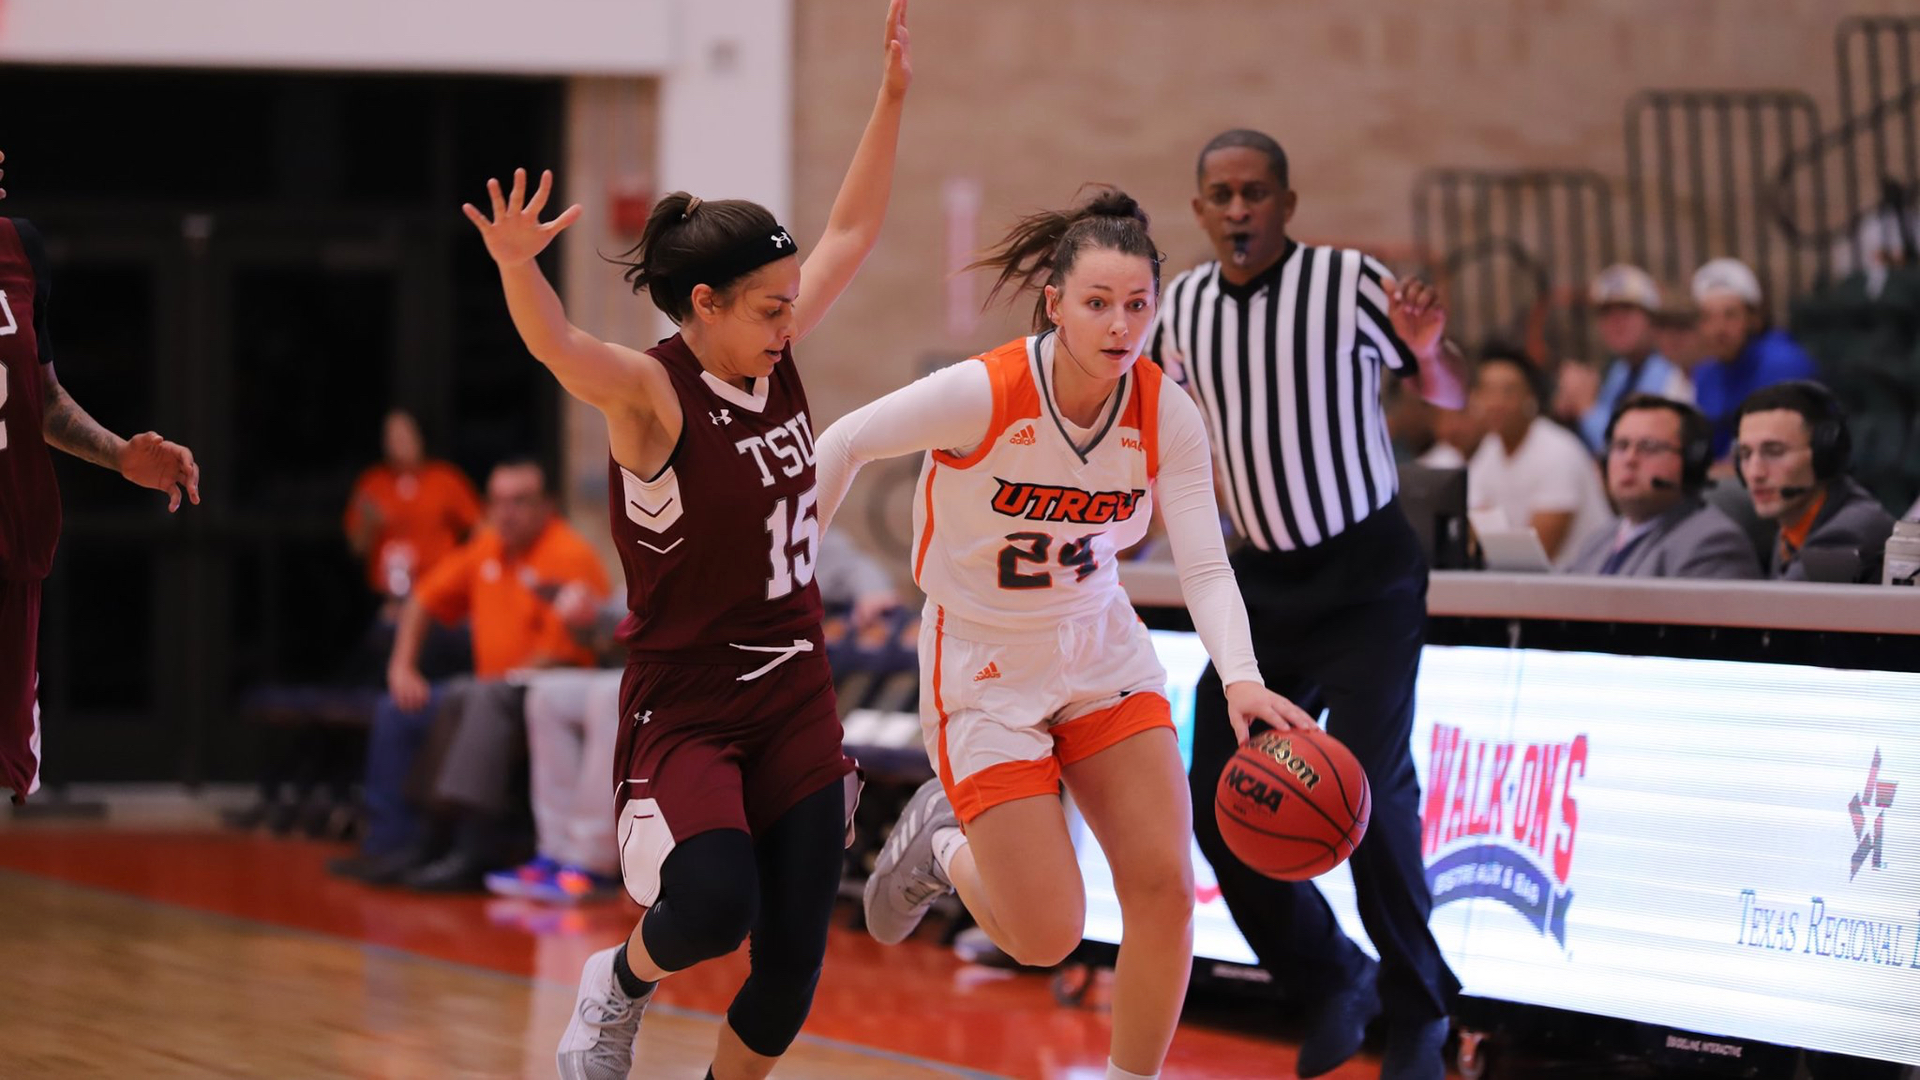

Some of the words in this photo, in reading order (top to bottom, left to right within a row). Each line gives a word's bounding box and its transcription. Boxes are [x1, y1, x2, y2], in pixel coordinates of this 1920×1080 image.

[735, 410, 816, 487] TSU
[991, 476, 1146, 524] UTRGV
[764, 484, 820, 600] 15
[997, 530, 1108, 589] 24
[1224, 764, 1285, 815] NCAA
